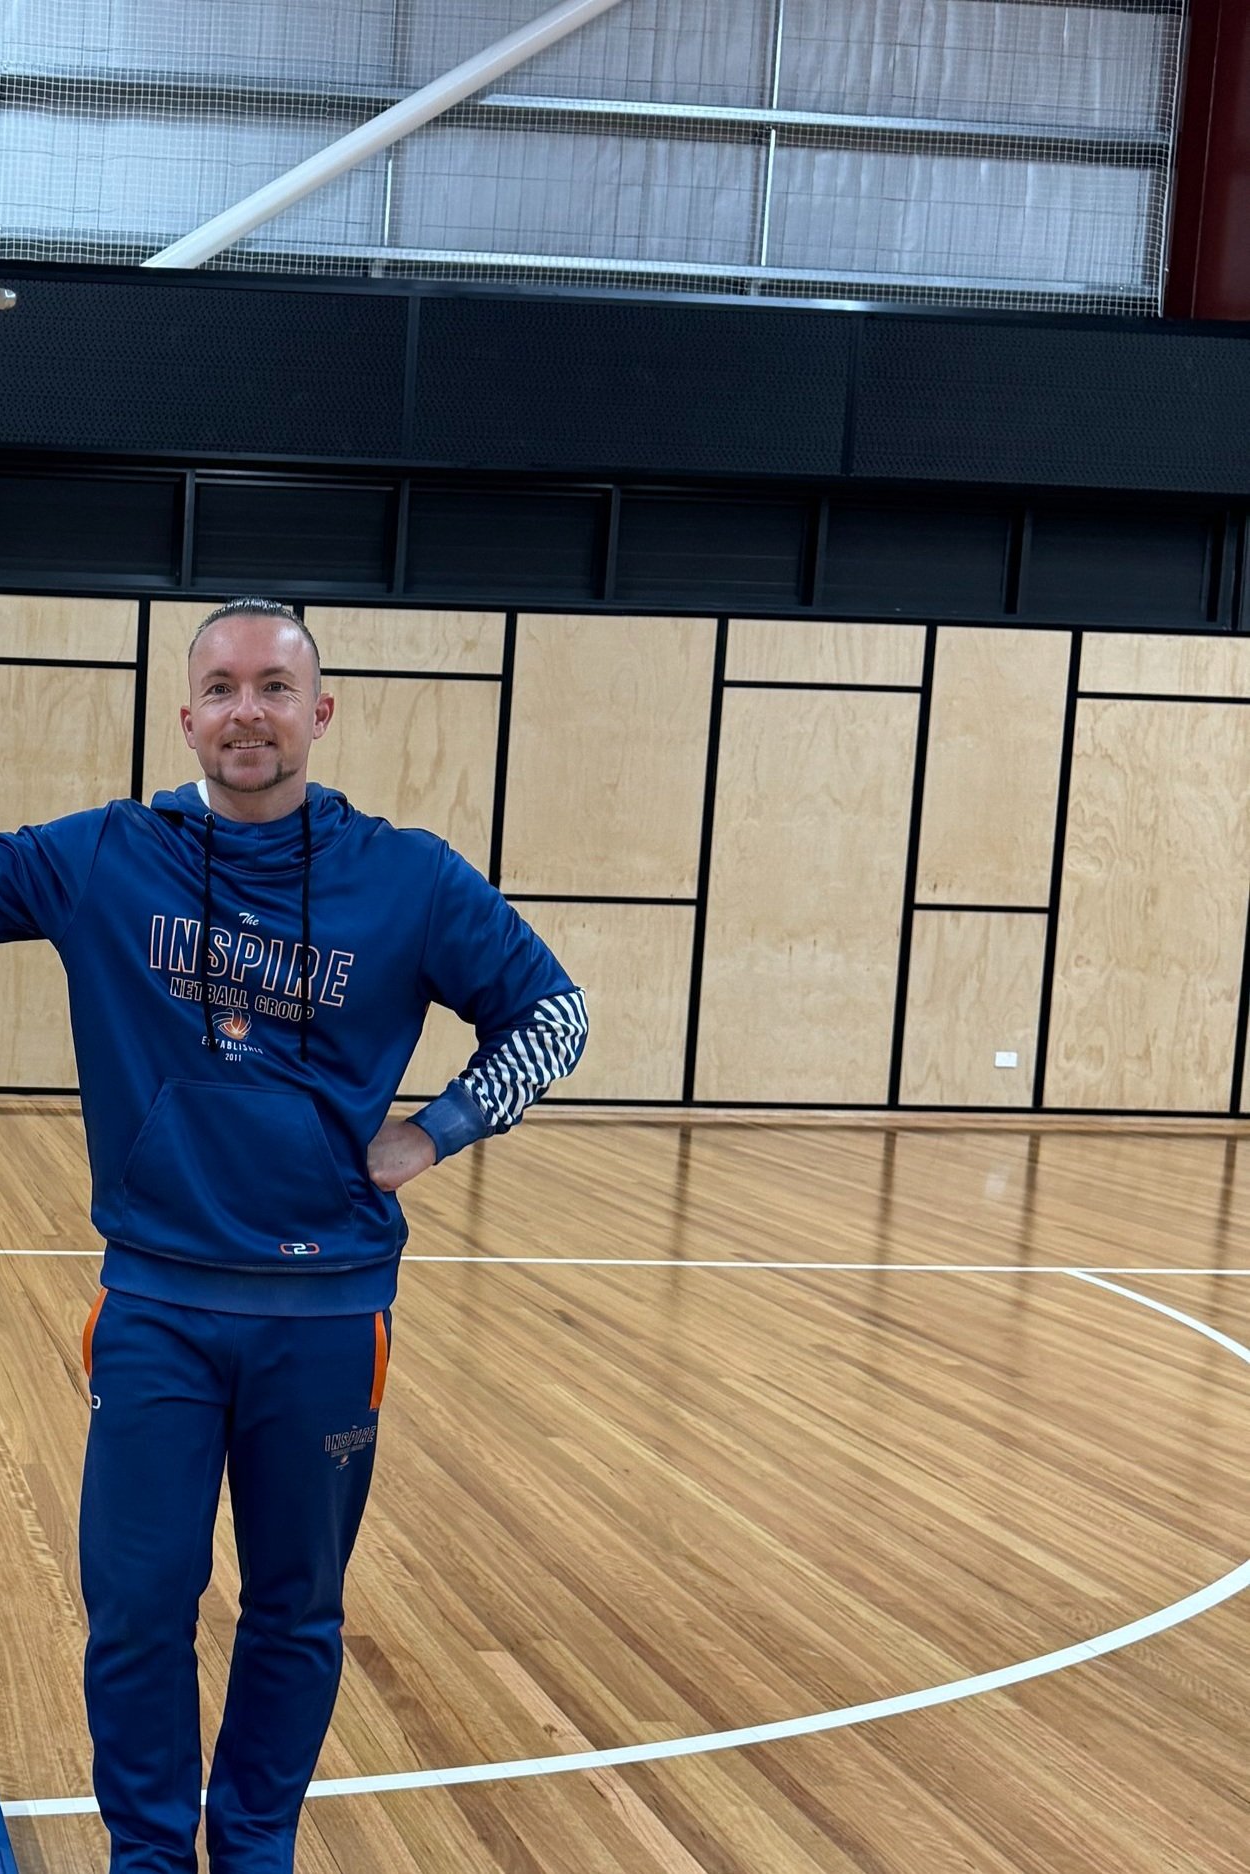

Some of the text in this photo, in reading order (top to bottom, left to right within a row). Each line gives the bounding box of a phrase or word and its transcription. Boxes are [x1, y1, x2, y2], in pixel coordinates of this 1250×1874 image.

[238, 912, 260, 926] The
[150, 914, 354, 1007] INSPIRE
[170, 976, 315, 1022] NETBALL GROUP
[225, 1052, 242, 1062] 2011
